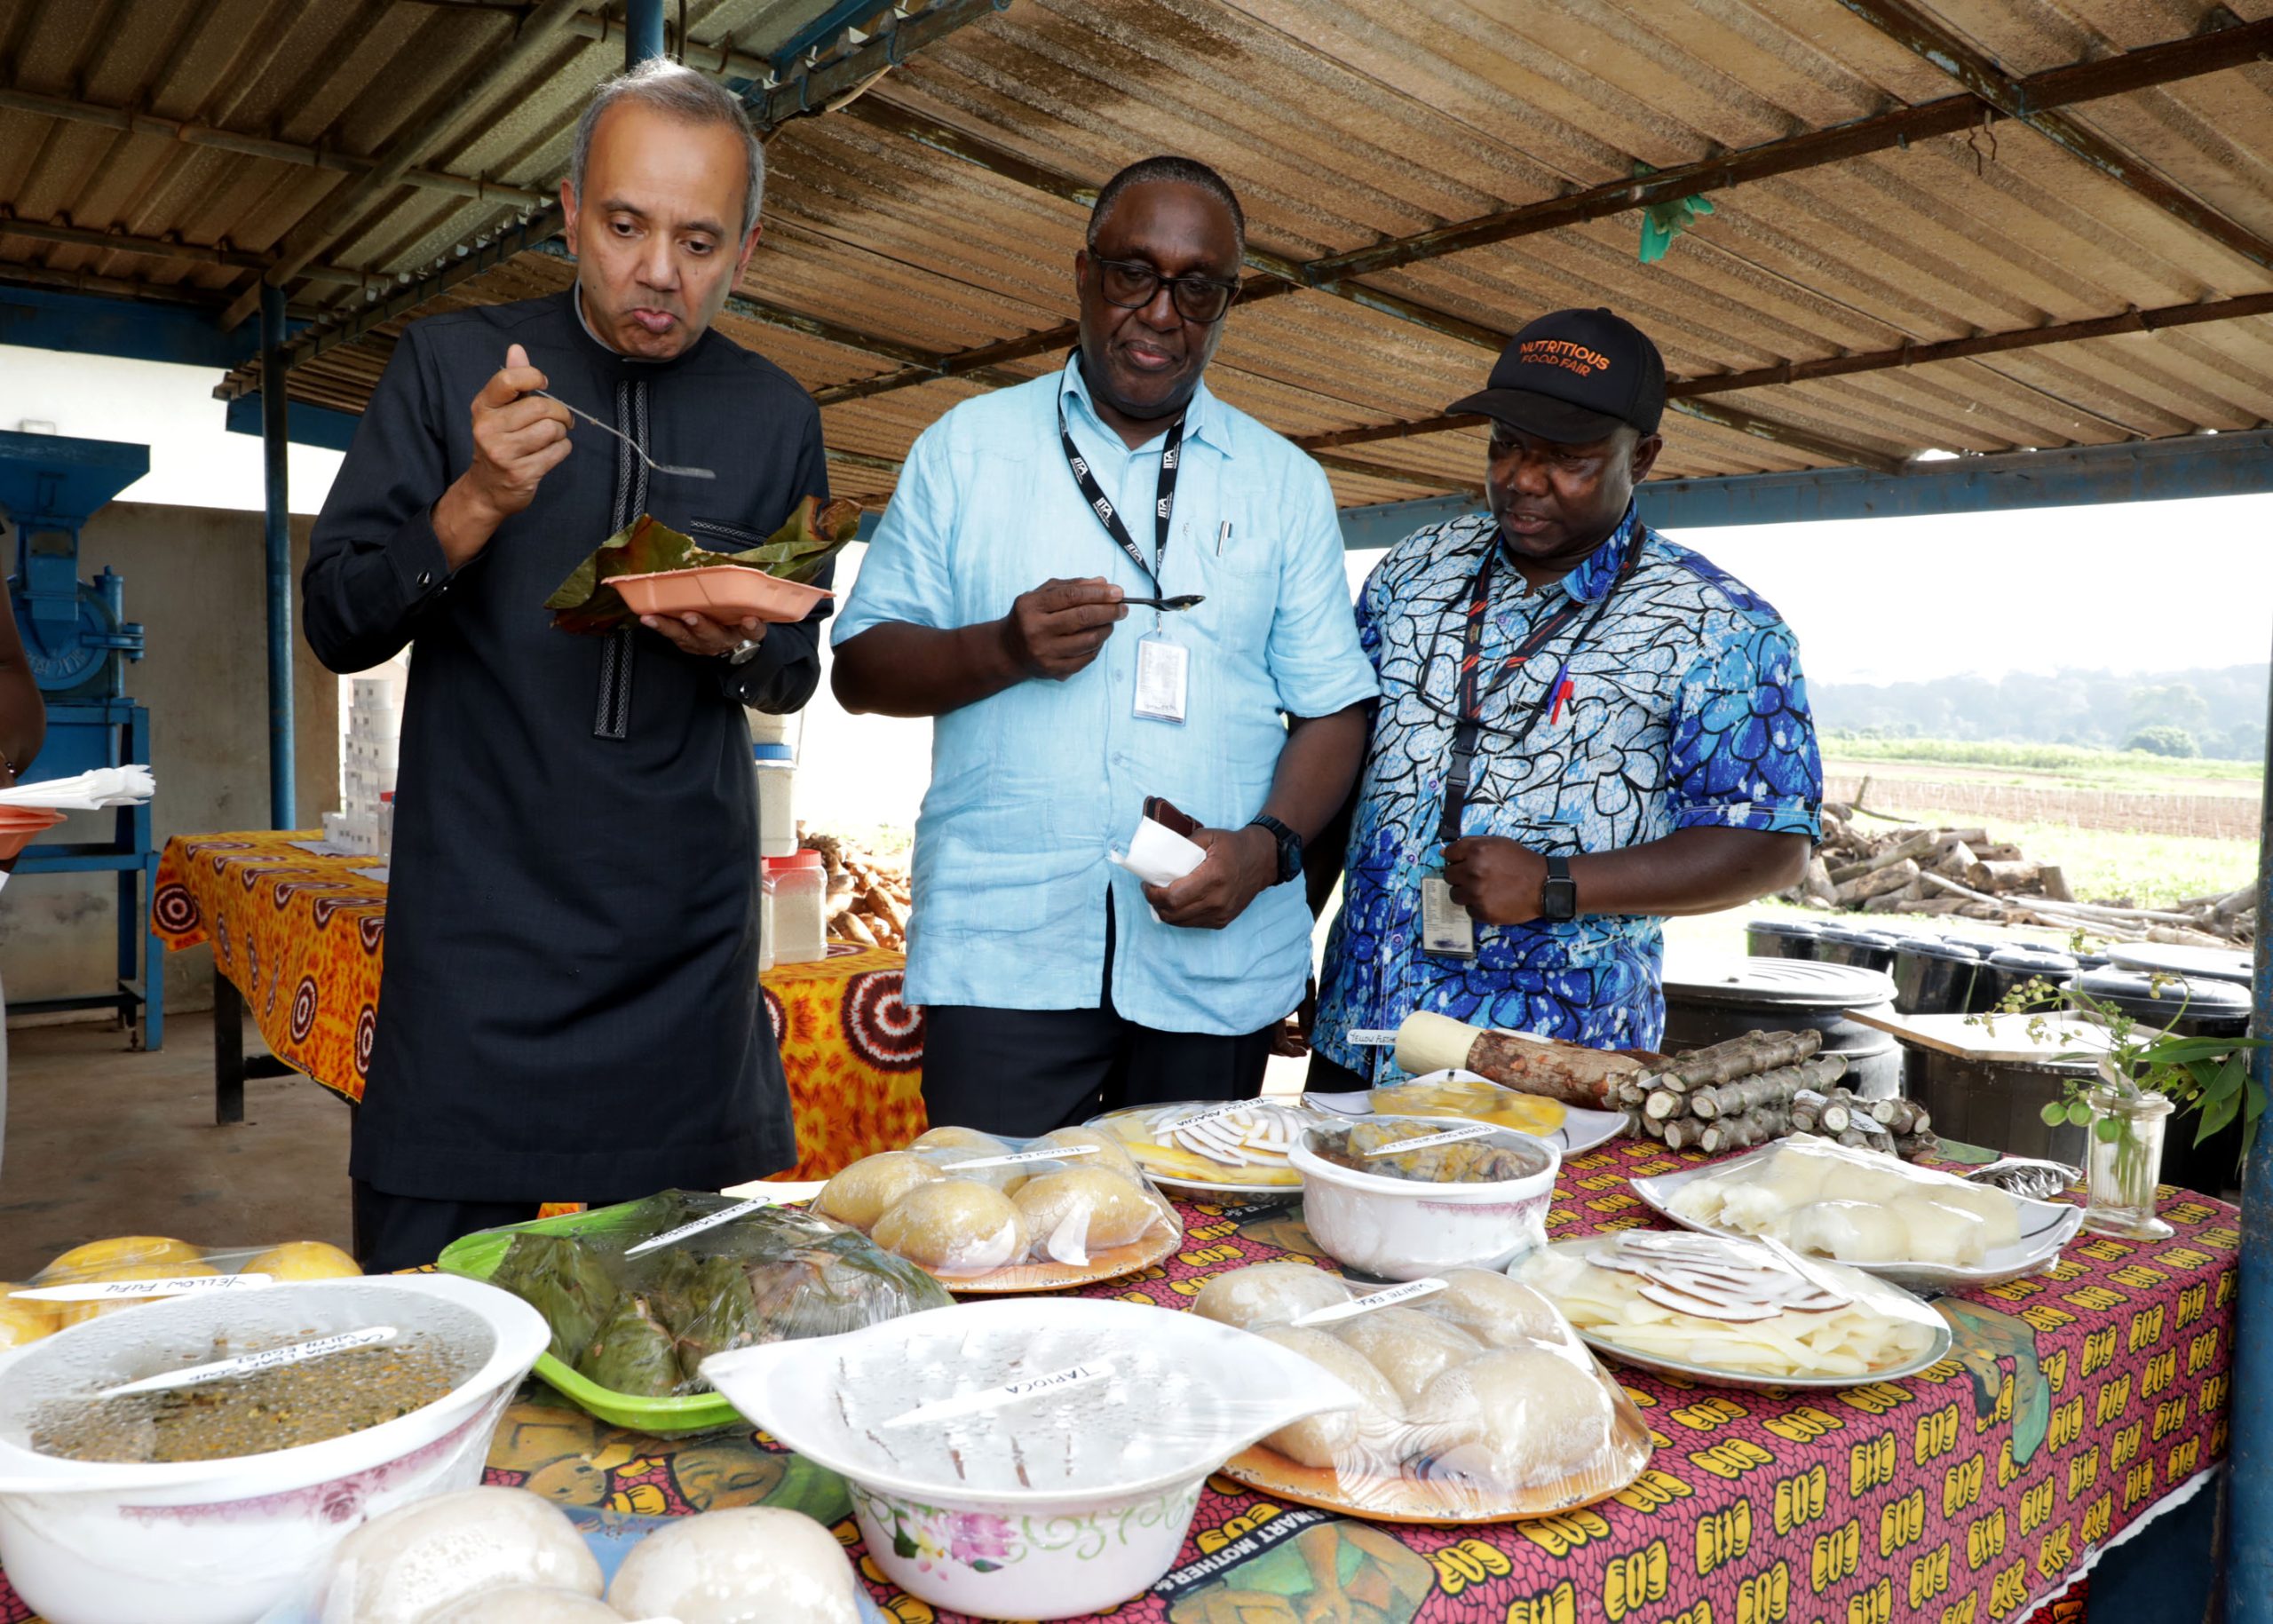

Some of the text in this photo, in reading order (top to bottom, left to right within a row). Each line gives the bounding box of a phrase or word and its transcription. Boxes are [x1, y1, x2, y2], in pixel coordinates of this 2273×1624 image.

[1519, 340, 1611, 370] NUTRITIOUS
[1520, 353, 1591, 377] FOOD FAIR
[1096, 497, 1113, 519] IITA
[1350, 1033, 1375, 1044] YELLOW
[1225, 1097, 1271, 1112] YELLOW
[105, 1276, 247, 1293] YELLOW FUFU
[1356, 1283, 1434, 1306] WHITE EBA
[237, 1334, 357, 1365] WITH EGUSI
[305, 1334, 384, 1355] CASSAVA
[1004, 1367, 1101, 1394] TAPIOCA
[1168, 1537, 1260, 1585] MOTHER
